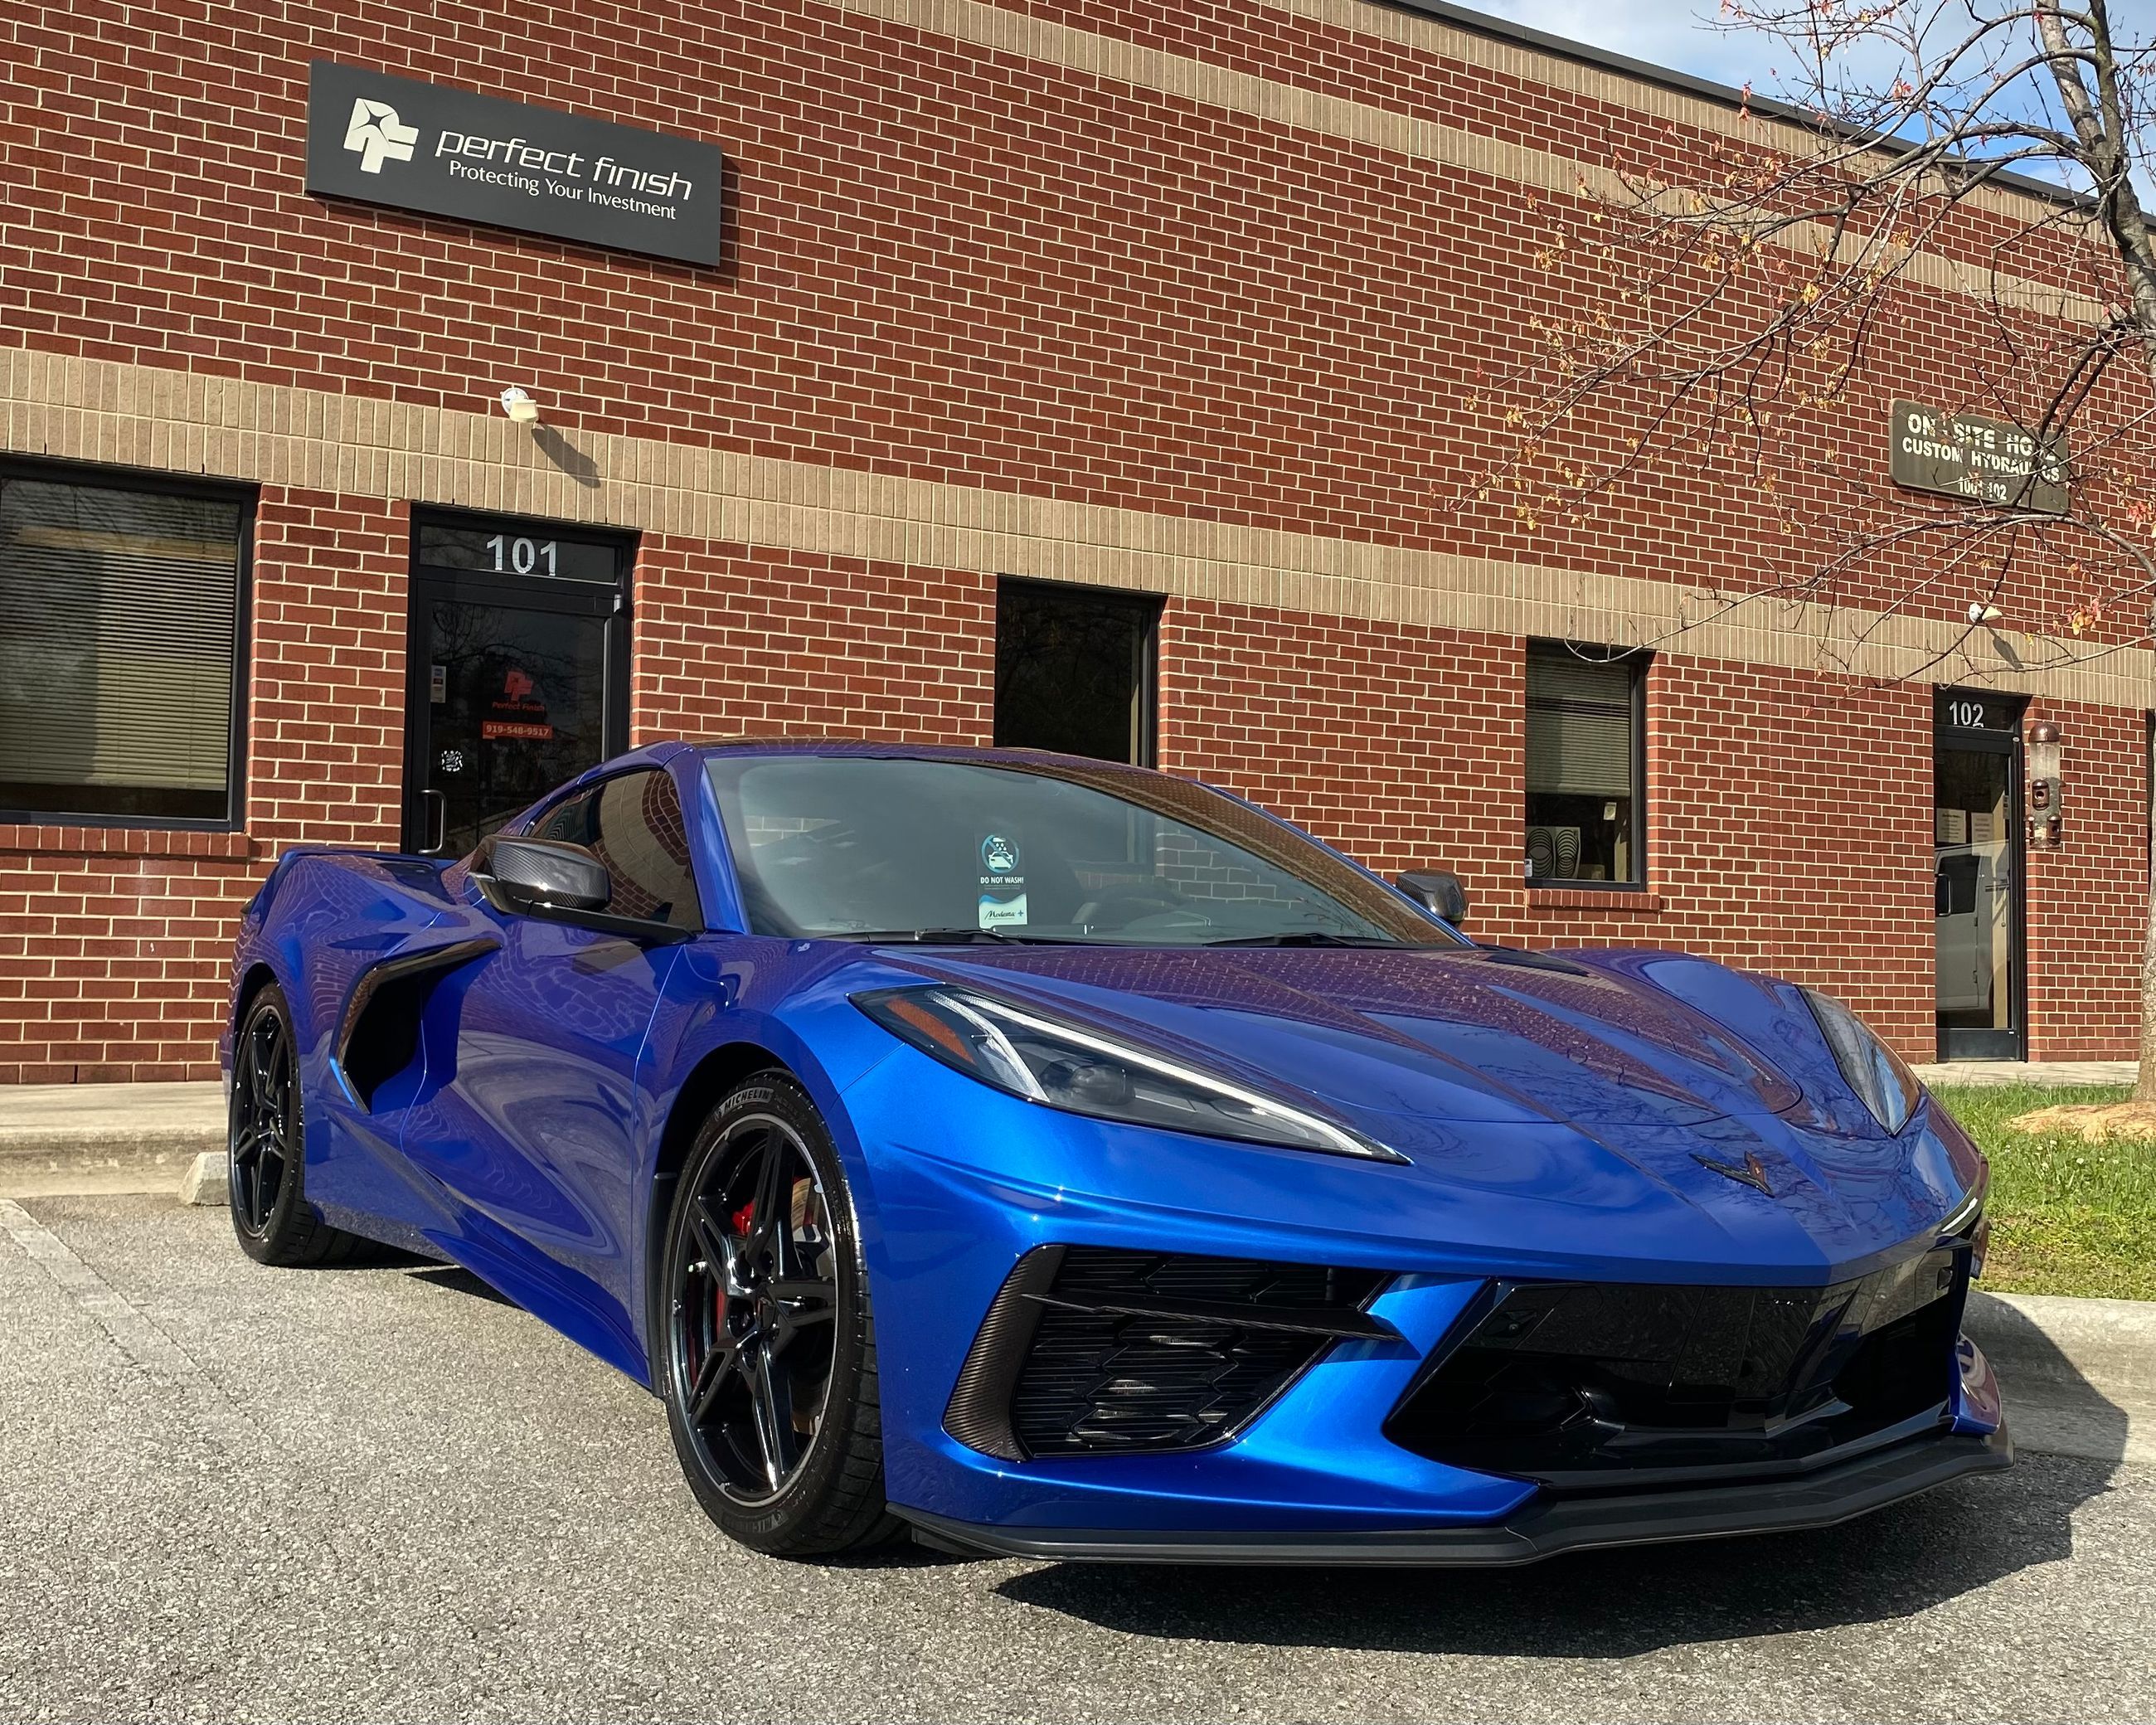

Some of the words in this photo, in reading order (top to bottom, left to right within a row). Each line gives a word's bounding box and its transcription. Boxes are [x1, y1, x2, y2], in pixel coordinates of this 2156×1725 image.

[435, 129, 584, 178] perfect
[593, 156, 693, 201] finish
[449, 161, 540, 196] Protecting
[545, 177, 584, 201] Your
[587, 187, 677, 220] Investment
[1902, 436, 1964, 464] CUSTOM
[486, 534, 557, 577] 101
[1949, 701, 1984, 727] 102
[486, 724, 549, 736] 919-548-9517
[724, 1089, 771, 1111] MICHELIN
